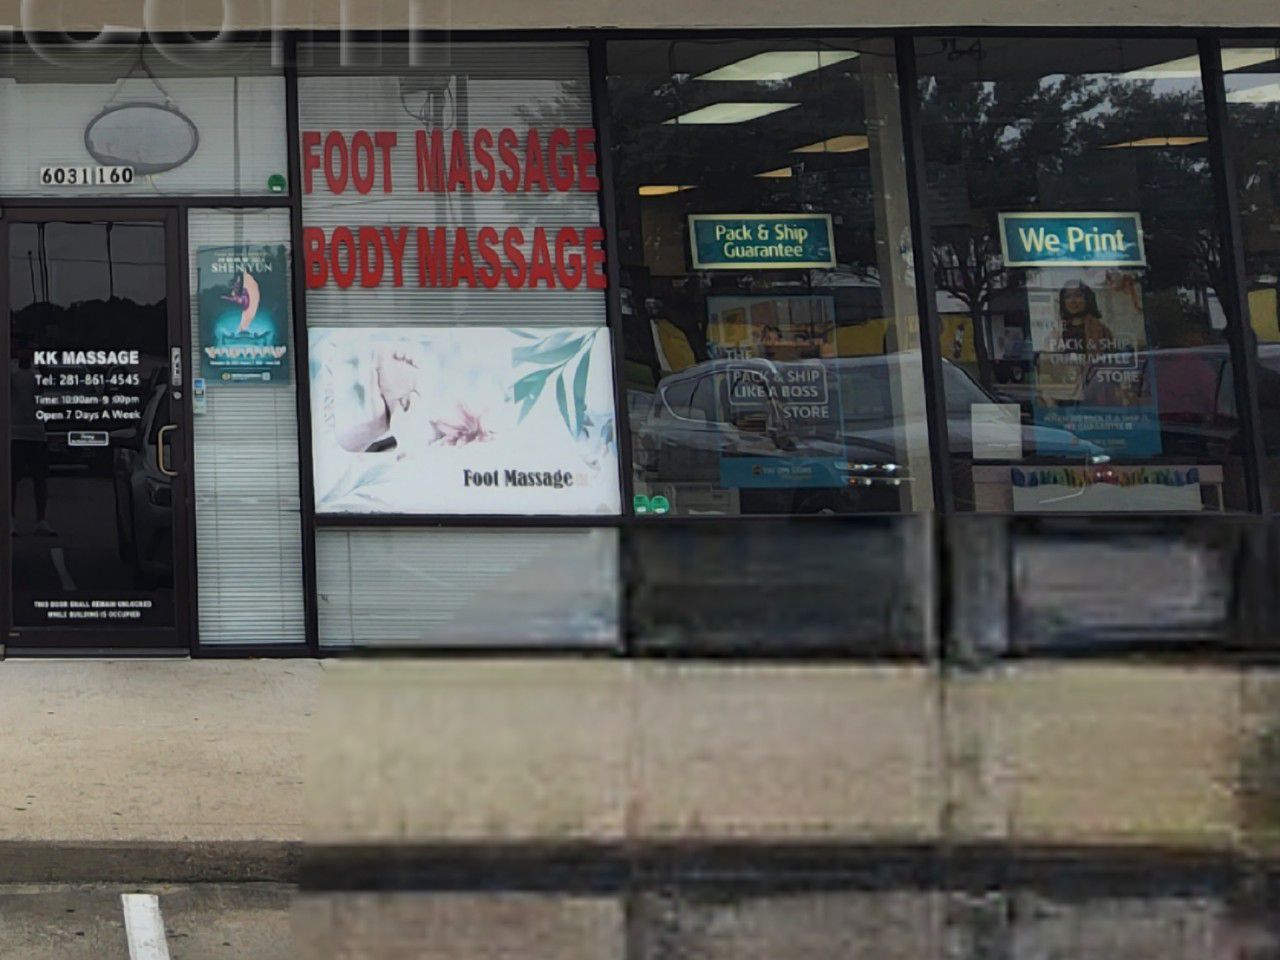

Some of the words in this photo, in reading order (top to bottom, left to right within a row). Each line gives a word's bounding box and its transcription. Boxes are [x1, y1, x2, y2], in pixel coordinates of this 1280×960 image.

[302, 130, 398, 195] FOOT
[415, 128, 601, 193] MASSAGE
[42, 168, 89, 185] 6031
[99, 167, 134, 184] 160
[715, 224, 753, 241] Pack
[757, 224, 770, 240] &
[774, 223, 809, 244] Ship
[1018, 227, 1061, 253] We
[1067, 226, 1126, 253] Print
[303, 226, 410, 289] BODY
[416, 226, 607, 289] MASSAGE
[723, 242, 803, 258] Guarantee
[33, 351, 59, 365] KK
[62, 351, 140, 365] MASSAGE
[787, 370, 820, 382] SHIP
[781, 385, 819, 398] BOSS
[783, 406, 830, 419] STORE
[463, 469, 500, 487] Foot
[504, 469, 574, 489] Massage
